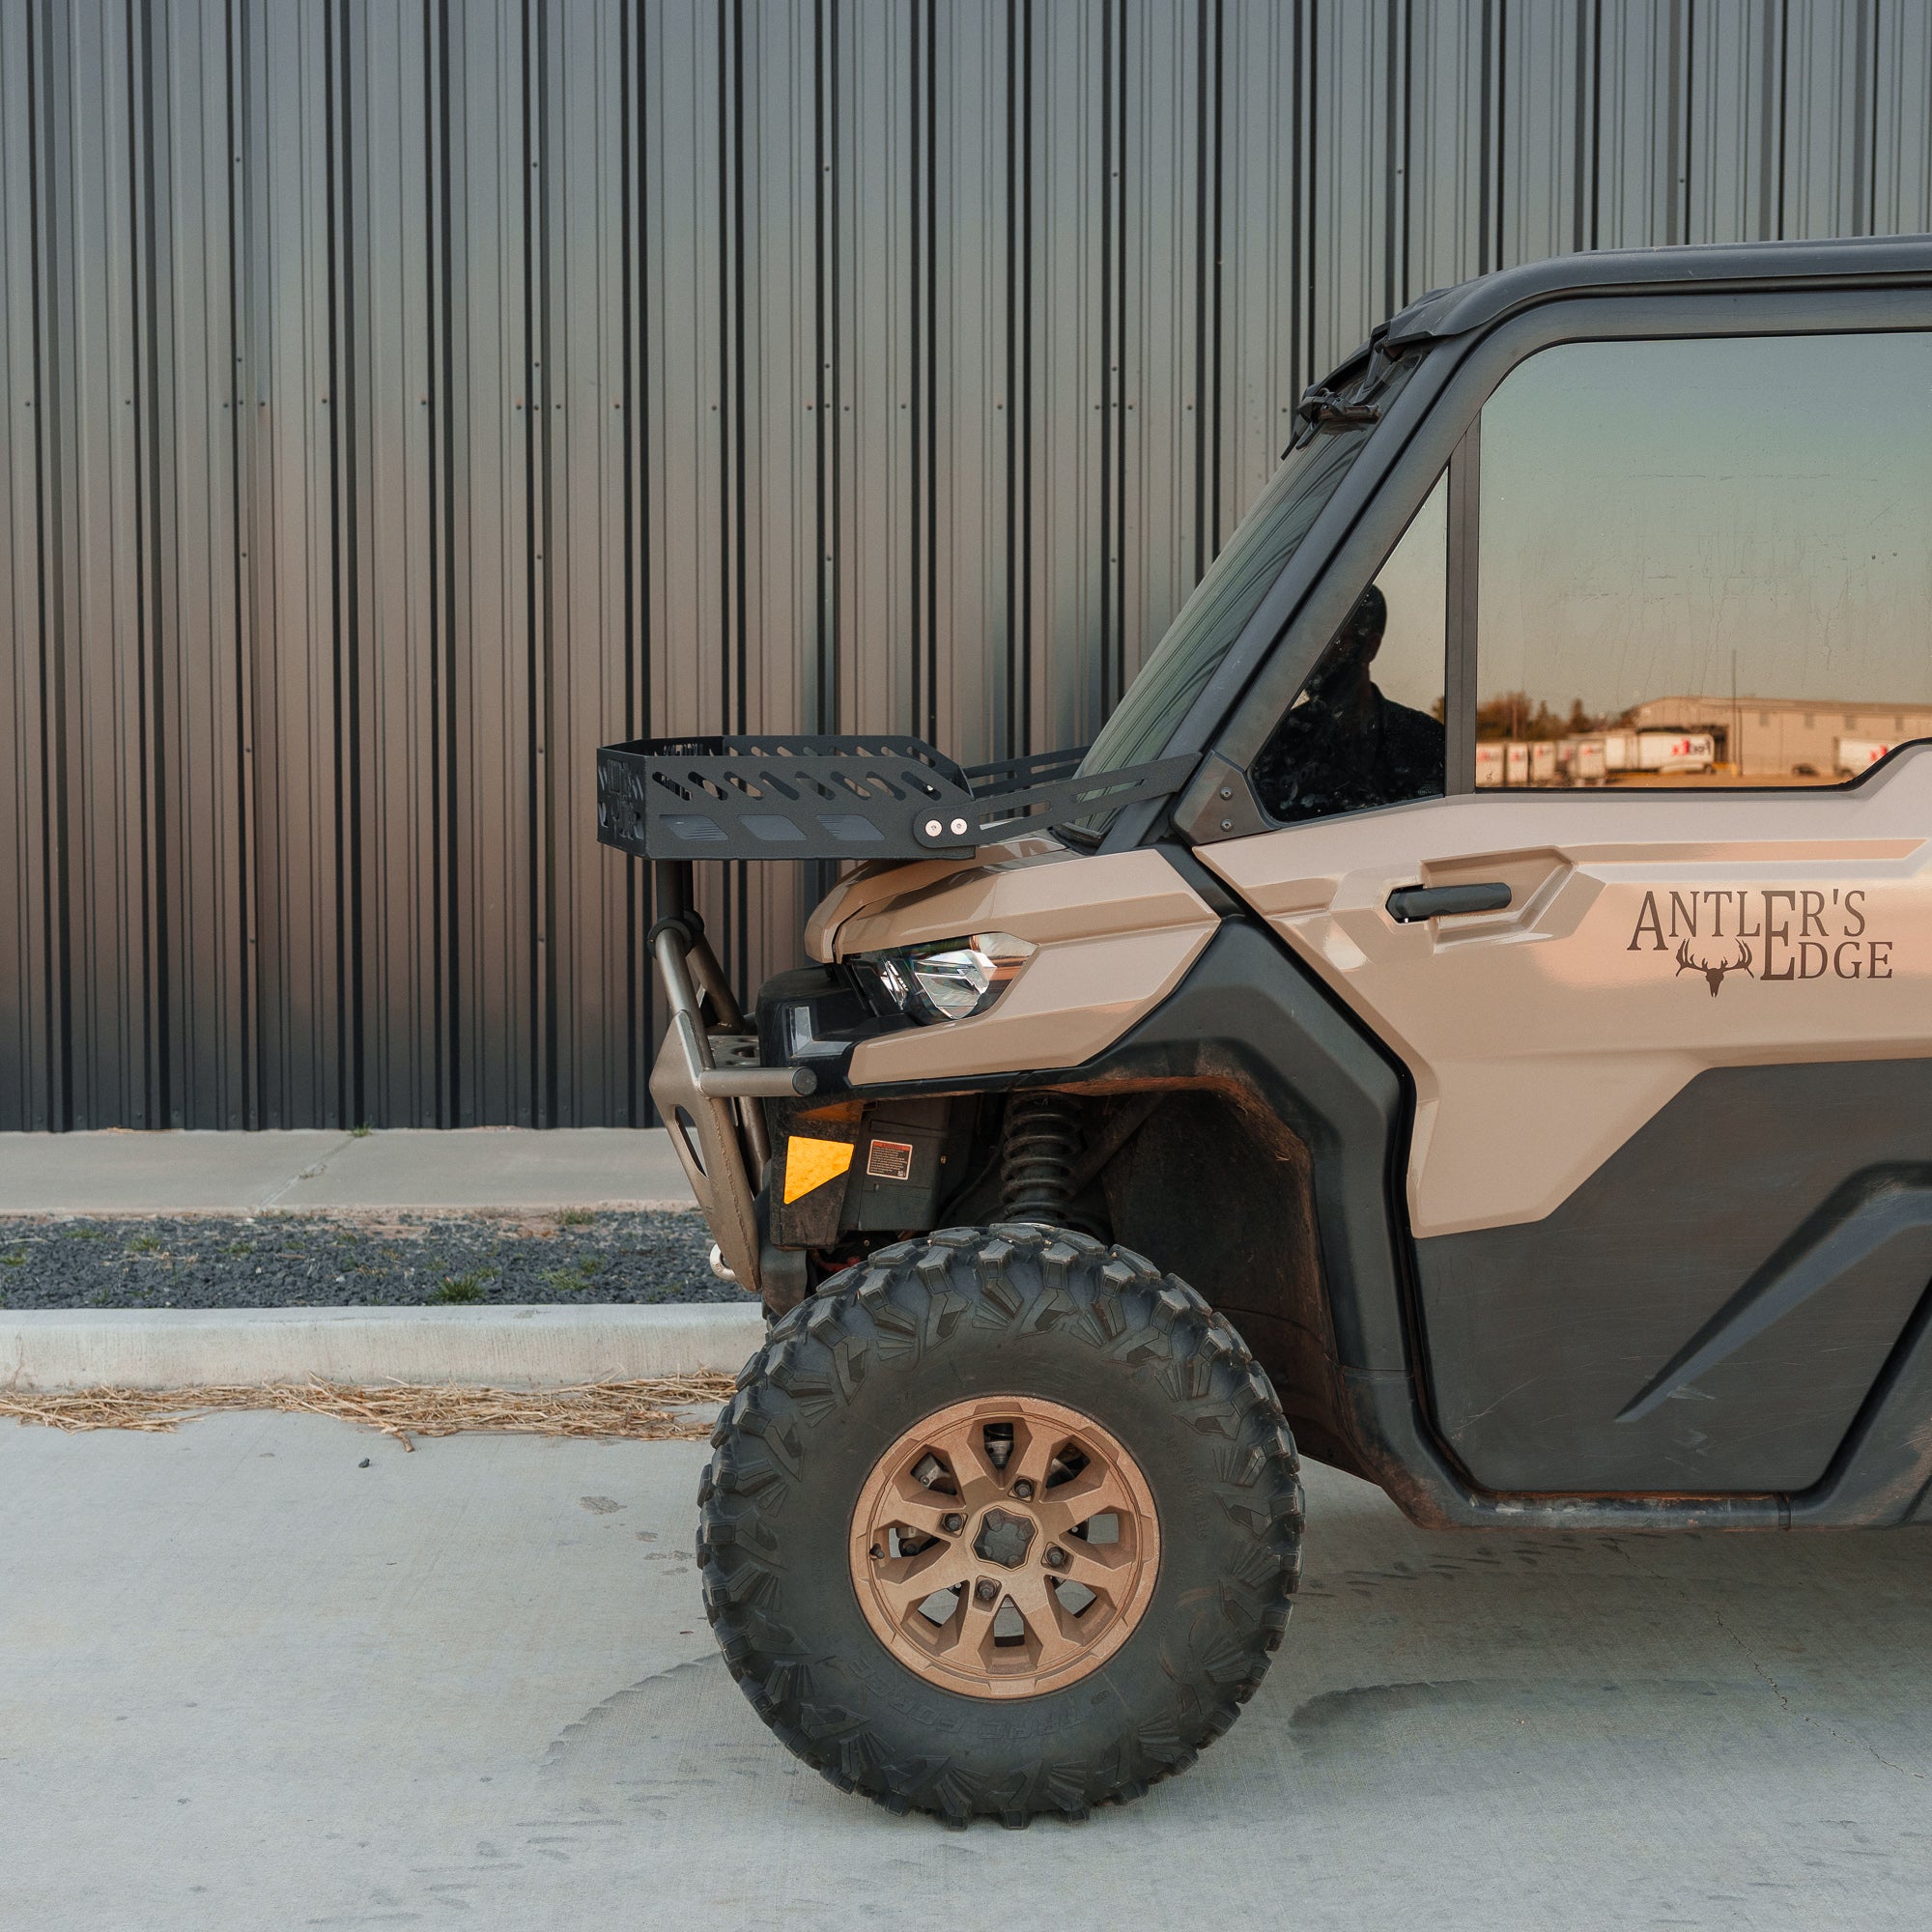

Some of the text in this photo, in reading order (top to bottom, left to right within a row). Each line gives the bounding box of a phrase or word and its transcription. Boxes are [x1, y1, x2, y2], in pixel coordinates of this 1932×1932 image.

[1627, 889, 1865, 980] ANTLER'S
[1760, 890, 1893, 980] EDGE
[845, 1656, 1092, 1739] TRAC FORCE
